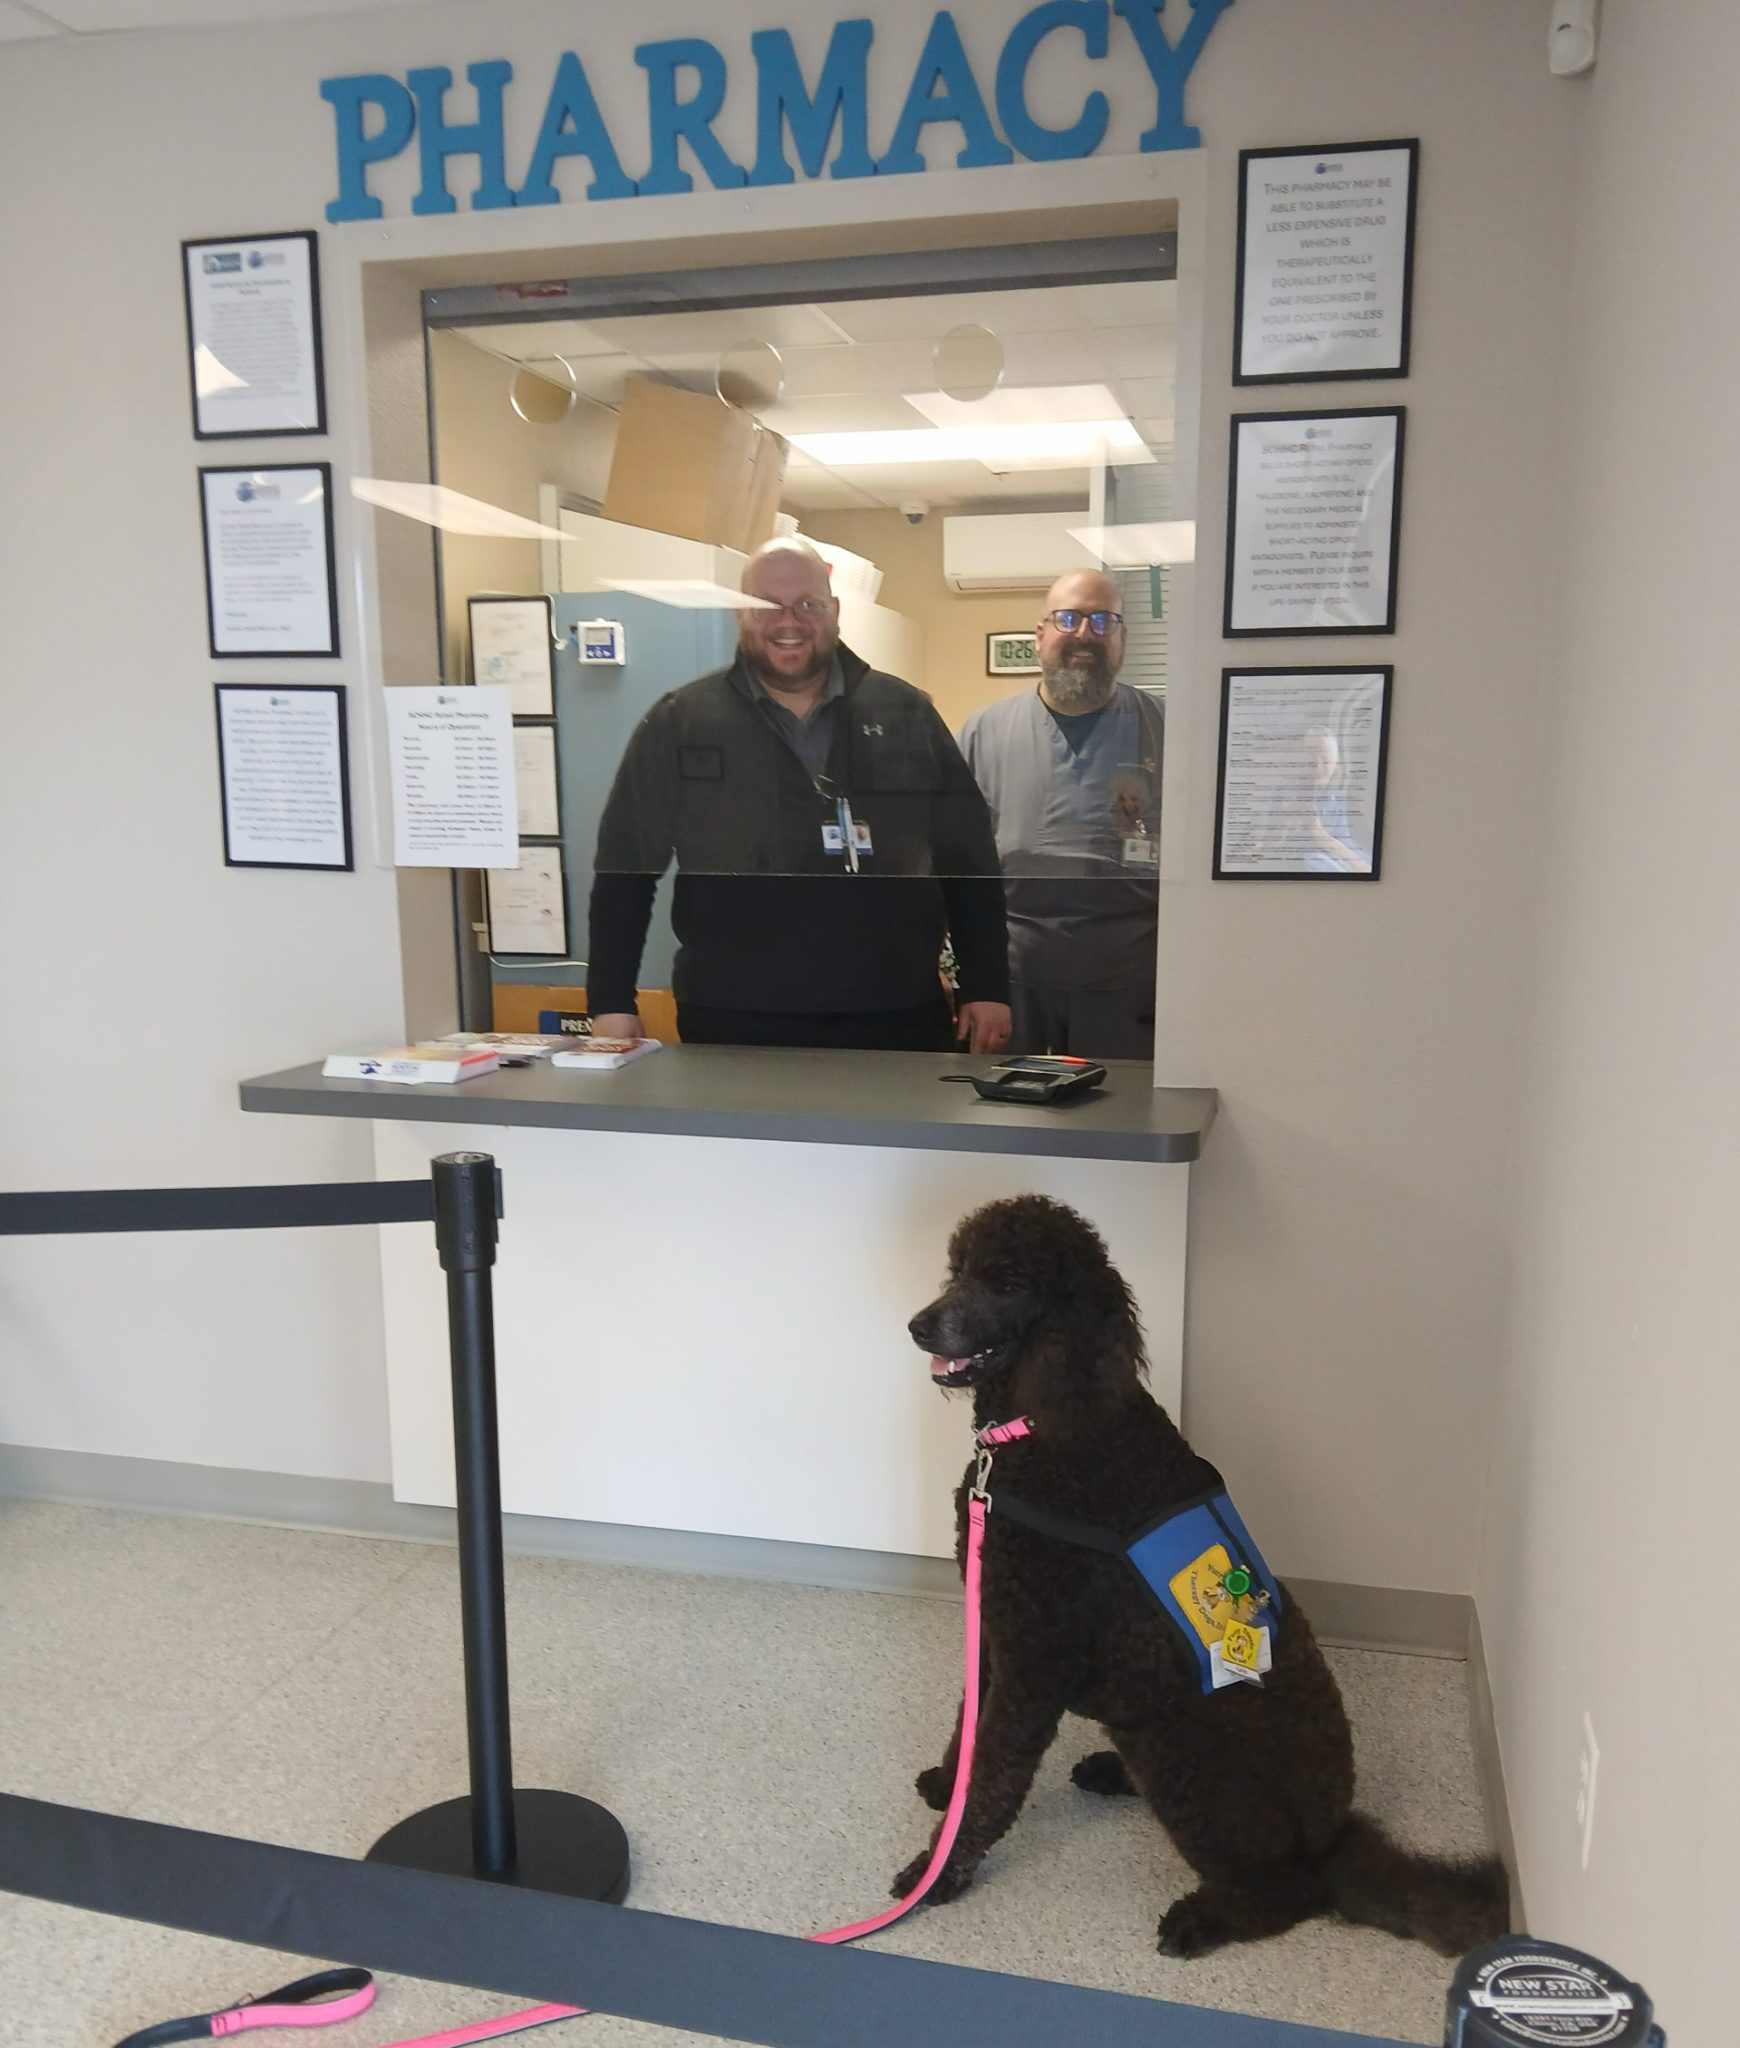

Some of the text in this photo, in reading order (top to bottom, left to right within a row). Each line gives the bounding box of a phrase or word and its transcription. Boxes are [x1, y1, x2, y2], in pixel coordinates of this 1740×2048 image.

[319, 0, 1238, 224] PHARMACY
[1264, 178, 1392, 195] THIS PHARMACY MAY BE
[1271, 198, 1383, 213] ABLE TO SUBSTITUTE A
[1266, 216, 1387, 233] LESS EXPENSIVE DRUG
[1300, 237, 1351, 249] WHICH IS
[1277, 255, 1374, 268] THERAPEUTICALLY
[1271, 272, 1376, 288] EQUIVALENT TO THE
[1270, 291, 1378, 306] ONE PRESCRIBED BY
[1261, 310, 1384, 326] YOUR DOCTOR UNLESS
[1262, 334, 1285, 344] YOU
[1498, 1979, 1593, 1991] NEW STAR
